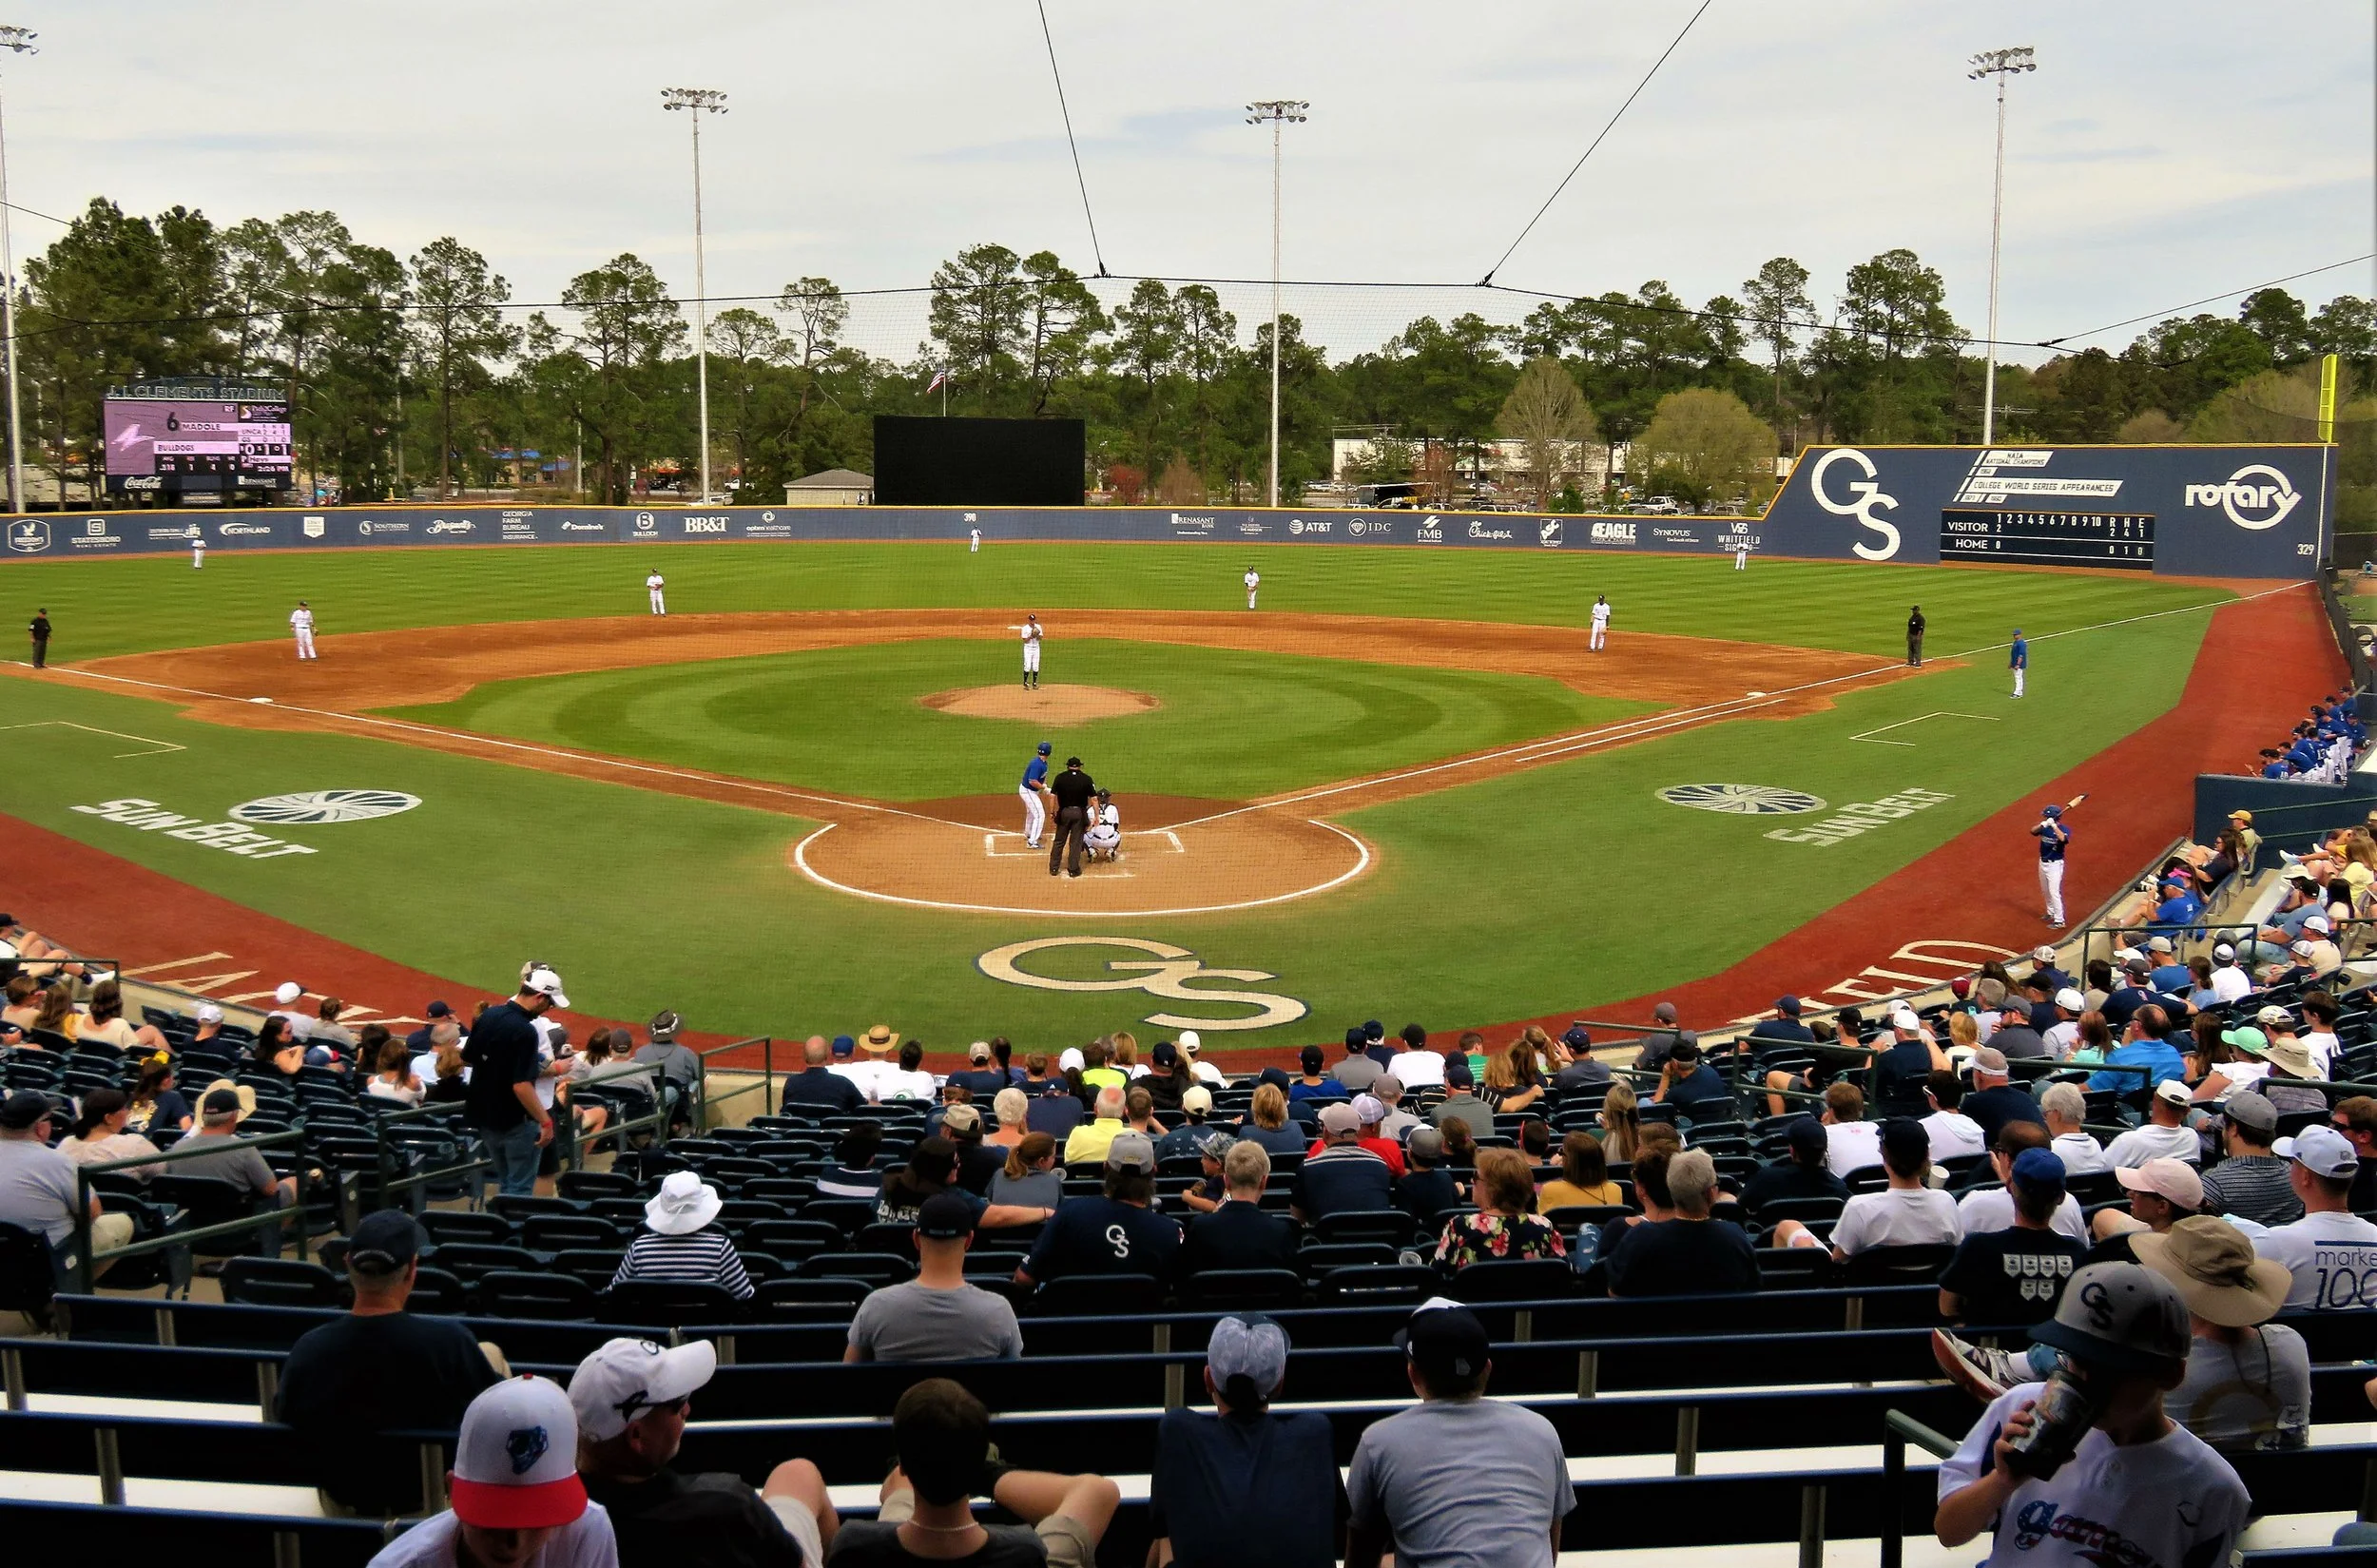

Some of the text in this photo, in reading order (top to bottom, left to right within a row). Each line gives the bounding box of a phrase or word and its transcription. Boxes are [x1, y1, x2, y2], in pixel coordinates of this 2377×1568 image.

[134, 385, 215, 398] CLEMENTS
[220, 387, 285, 399] STADIUM
[167, 412, 179, 431] 6
[245, 444, 255, 455] 0
[264, 444, 269, 455] 1
[282, 444, 287, 455] 1
[124, 475, 163, 489] Coca-Cola
[2004, 482, 2030, 491] WORLD
[2059, 483, 2115, 493] APPEARANCES
[1810, 448, 1901, 561] GS
[2185, 474, 2302, 521] rotary
[684, 517, 730, 532] BB&T
[963, 513, 977, 522] 390
[1997, 513, 2145, 529] 1 2 3 4 5 6 7 8 9 10 R H E
[1304, 522, 1333, 532] AT&T
[1369, 523, 1392, 532] IDC
[1417, 529, 1443, 539] FMB
[1468, 523, 1514, 540] Chick-fil-A
[1594, 523, 1636, 538] EAGLE
[1652, 528, 1691, 536] SYNOVUS
[1947, 521, 2143, 538] VISITOR 2 2 4 1
[1717, 534, 1761, 544] WHITFIELD
[1955, 538, 1987, 550] HOME
[2109, 546, 2115, 554] 0
[2124, 546, 2128, 555] 1
[2297, 544, 2314, 555] 329
[973, 936, 1312, 1031] GS
[1106, 1224, 1130, 1258] GS
[2080, 1282, 2114, 1330] GS
